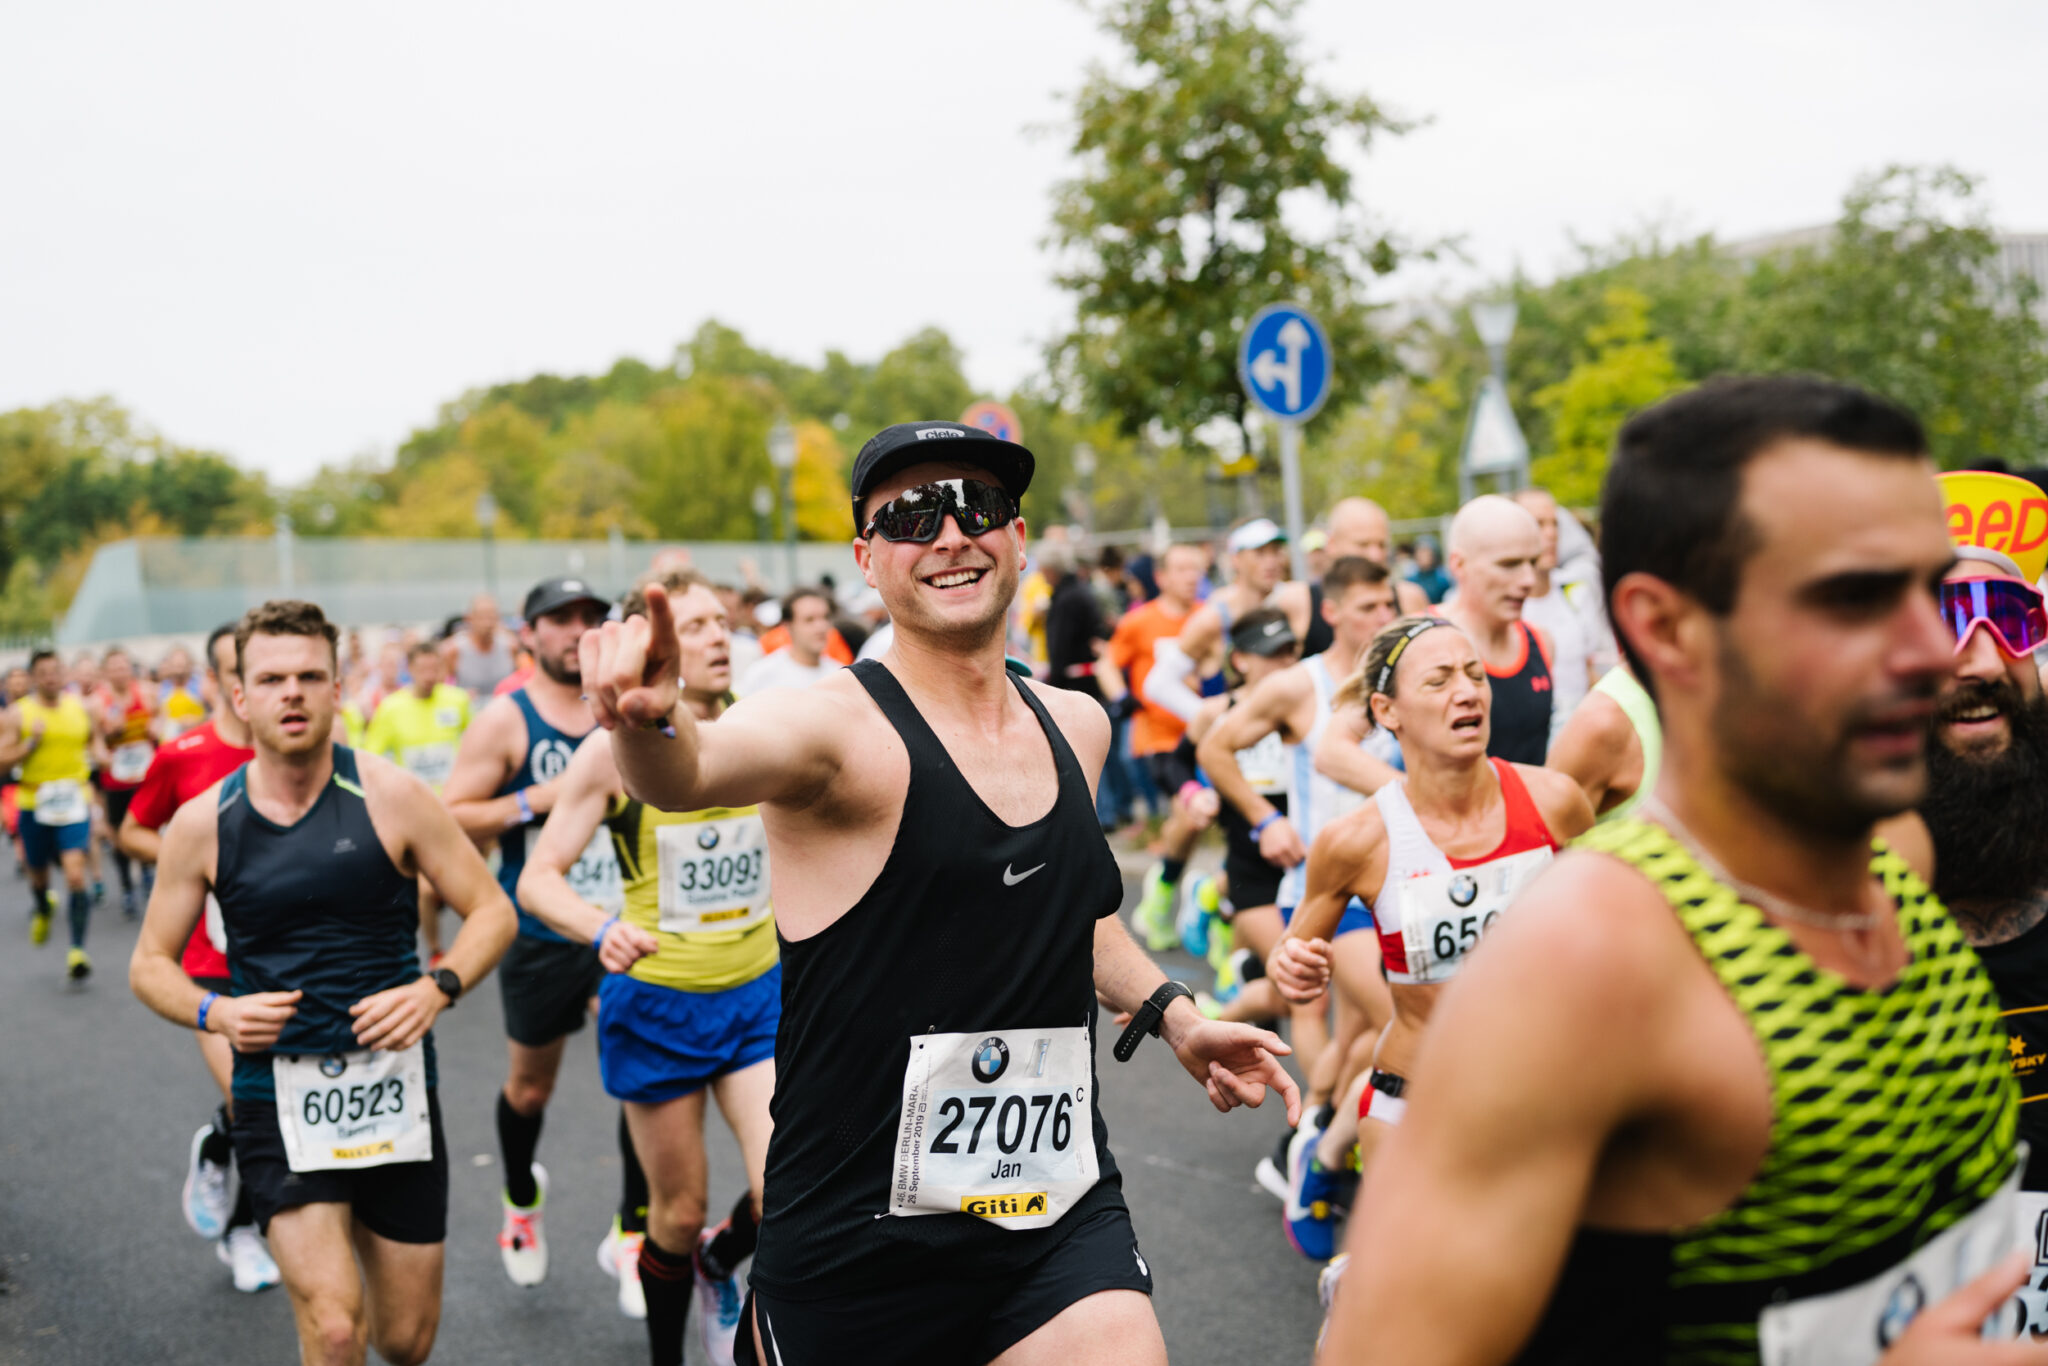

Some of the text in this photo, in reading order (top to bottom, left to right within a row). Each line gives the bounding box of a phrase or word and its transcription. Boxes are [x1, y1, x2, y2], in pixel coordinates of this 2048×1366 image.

[303, 1079, 404, 1126] 60523
[1076, 1086, 1085, 1103] C
[929, 1092, 1073, 1155] 27076
[908, 1115, 925, 1204] 29. September 2019
[991, 1159, 1022, 1179] Jan
[898, 1164, 909, 1191] BMW
[967, 1198, 1018, 1215] Giti
